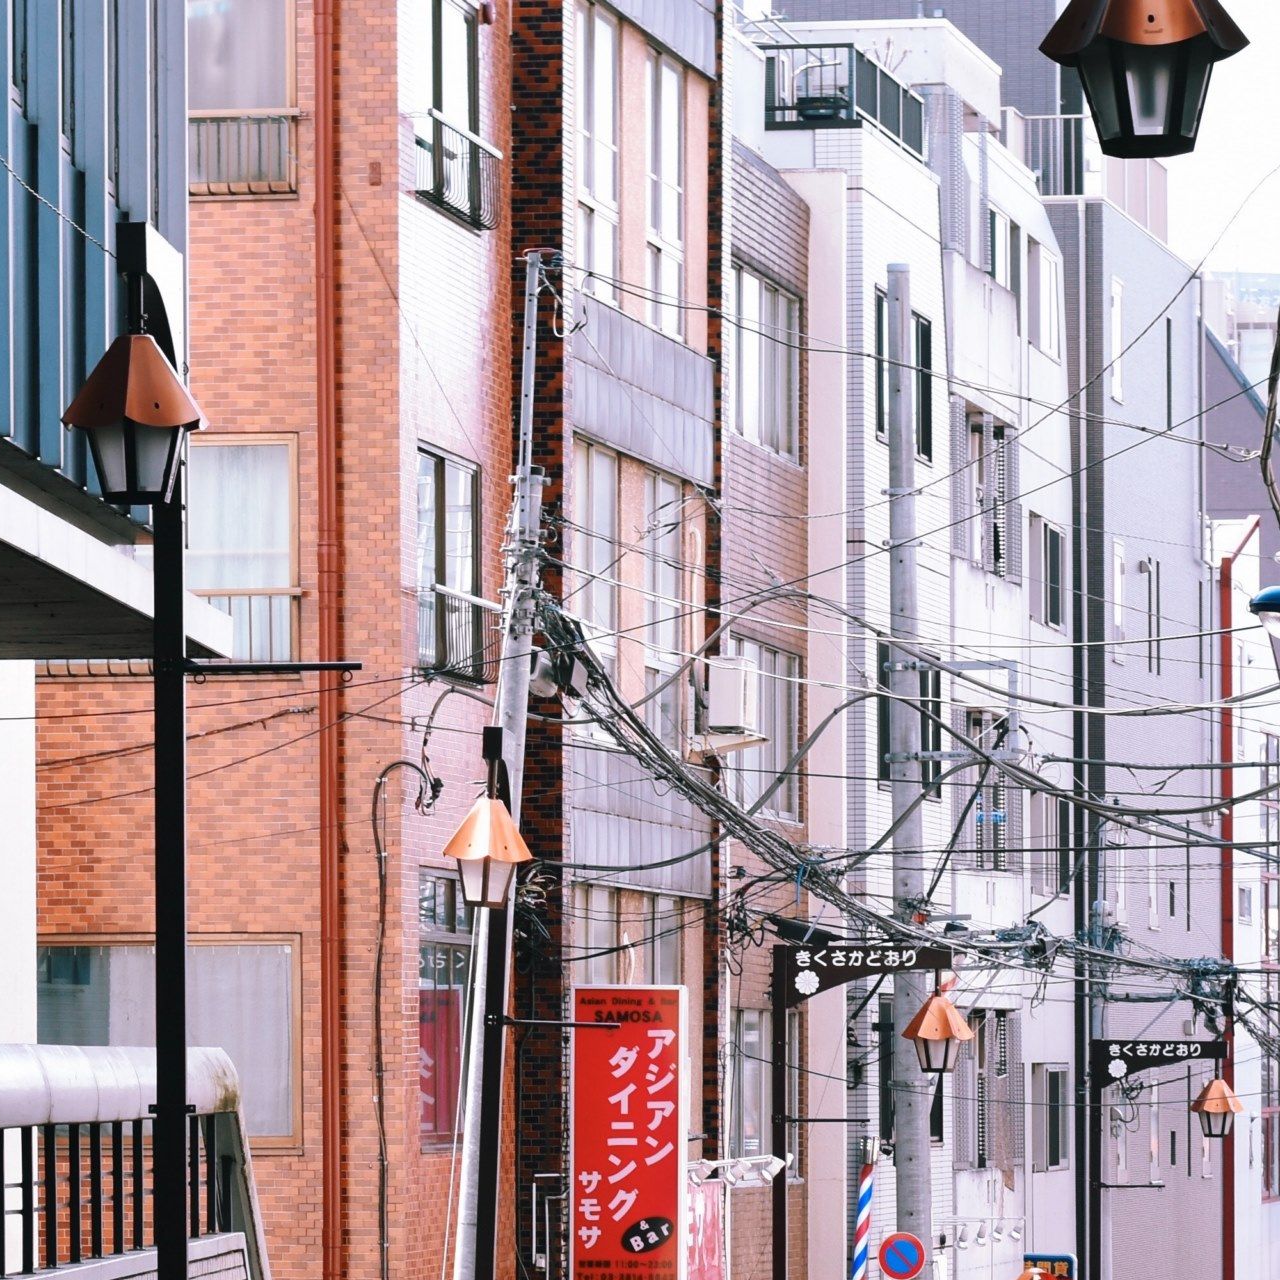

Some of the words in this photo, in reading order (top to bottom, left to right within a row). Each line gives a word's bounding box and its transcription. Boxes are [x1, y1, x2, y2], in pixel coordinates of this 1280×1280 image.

[795, 950, 917, 967] きくさかどおり
[594, 1010, 663, 1023] SAMOSA
[1108, 1043, 1201, 1056] きくさかどおり
[645, 1029, 677, 1166] アジアン
[607, 1045, 640, 1222] ダイニング
[578, 1170, 603, 1249] サモサ
[639, 1220, 650, 1230] &
[629, 1223, 670, 1252] Bar
